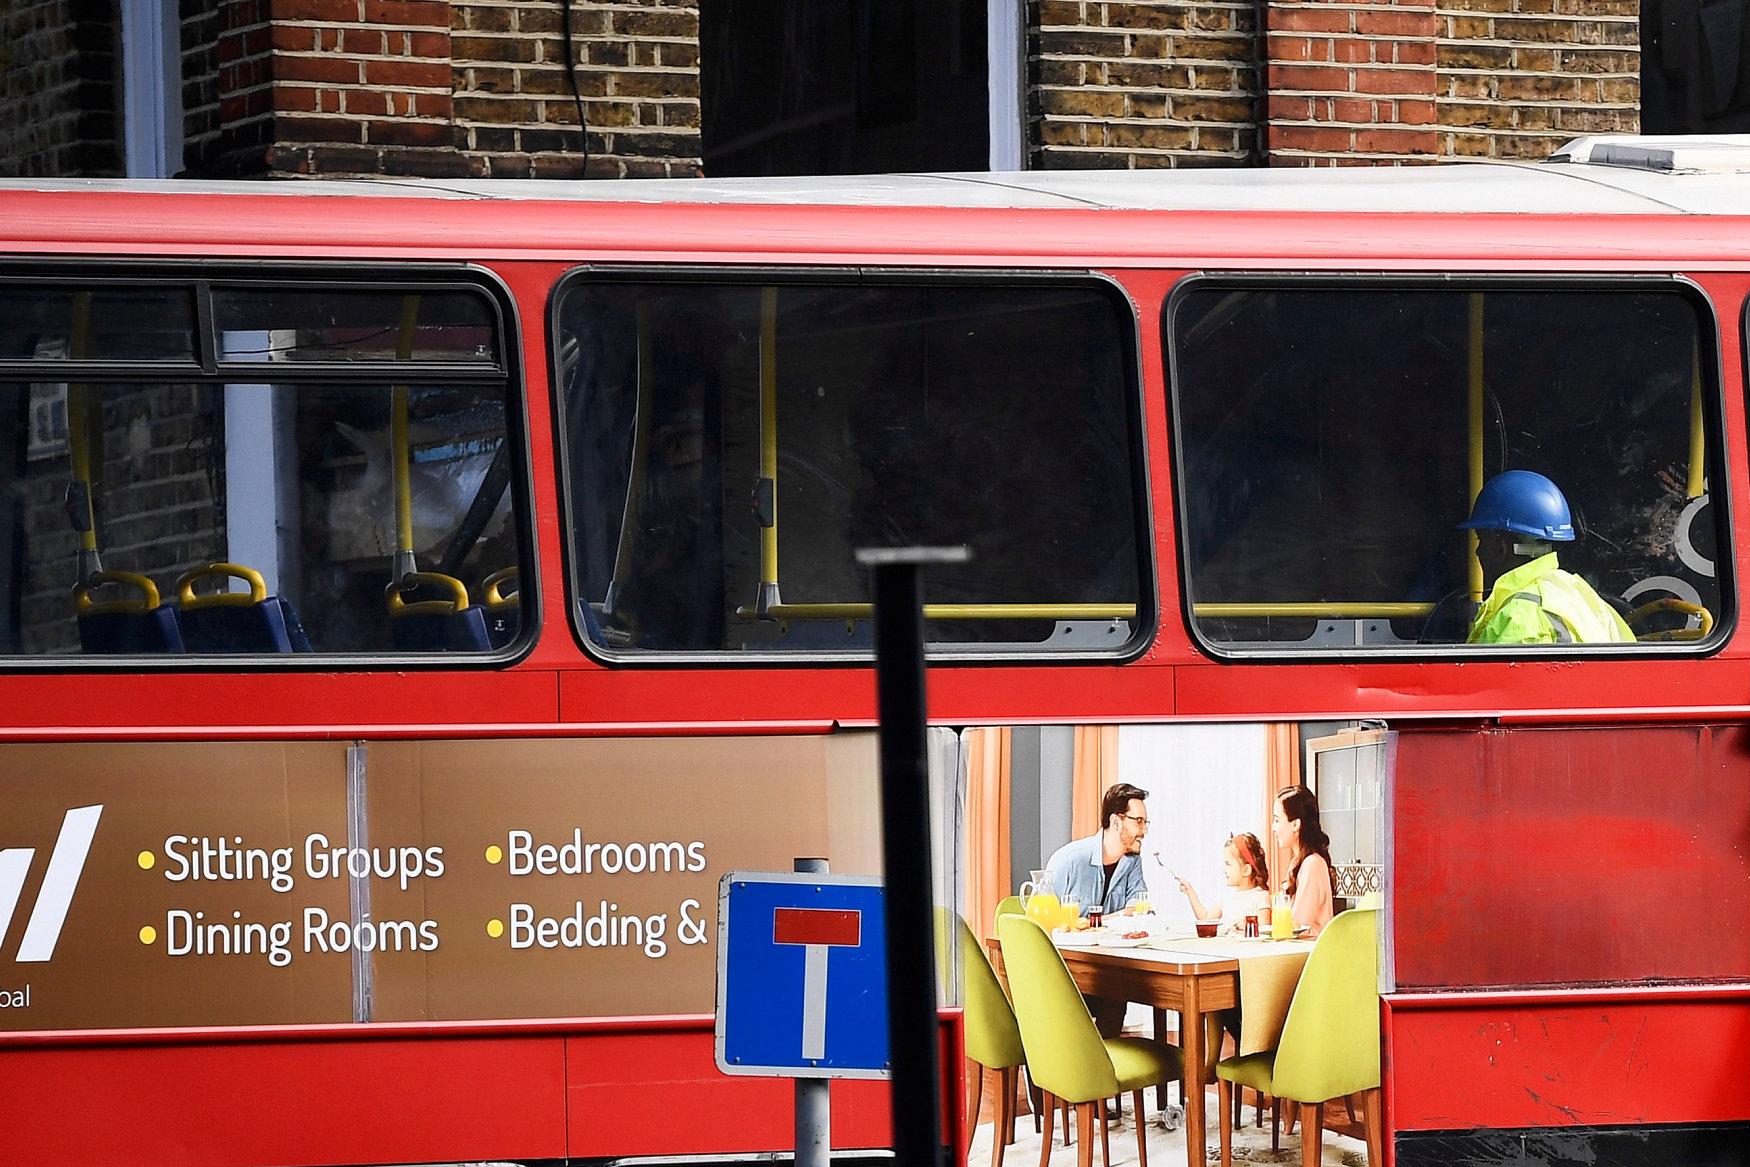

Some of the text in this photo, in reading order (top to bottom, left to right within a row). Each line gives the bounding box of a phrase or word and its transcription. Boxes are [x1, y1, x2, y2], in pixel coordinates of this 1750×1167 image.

[163, 832, 446, 893] Sitting Groups
[509, 828, 708, 877] Bedrooms
[166, 906, 440, 967] Dining Rooms
[510, 898, 709, 958] Bedding &
